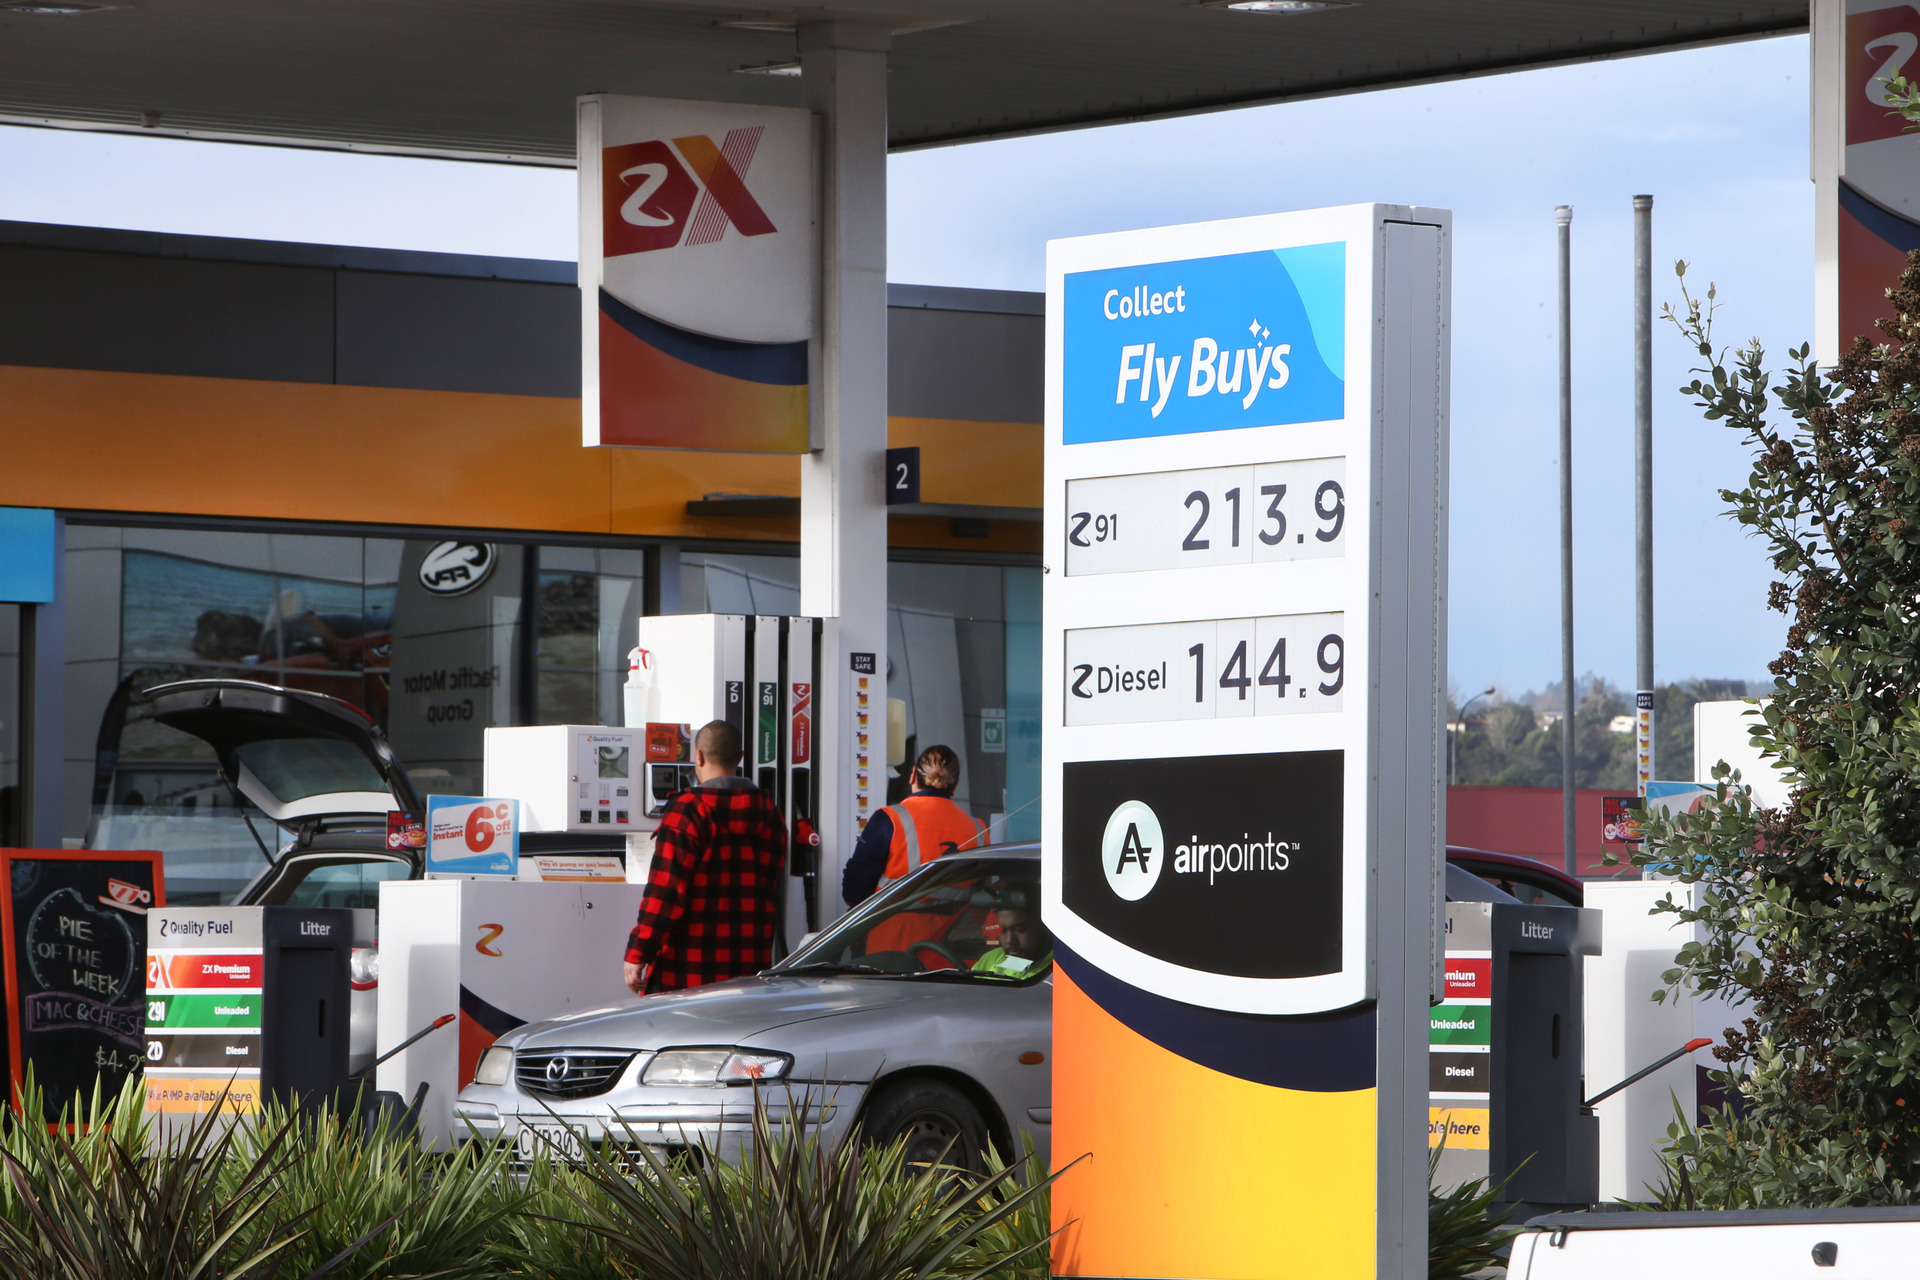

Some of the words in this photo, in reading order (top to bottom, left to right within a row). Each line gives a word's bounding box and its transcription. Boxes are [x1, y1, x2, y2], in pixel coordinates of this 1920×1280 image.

[1103, 284, 1187, 321] Collect
[1115, 342, 1182, 419] Fly
[1187, 336, 1291, 411] Buys
[896, 462, 909, 489] 2
[1182, 480, 1345, 551] 213.9
[1188, 633, 1345, 703] 144.9
[1097, 661, 1167, 694] Diesel
[496, 819, 511, 832] off
[433, 829, 464, 841] Instant
[1174, 831, 1289, 886] airpoints
[58, 915, 94, 942] PIE
[170, 920, 204, 937] Quality
[207, 920, 233, 934] Fuel
[300, 921, 331, 936] Litter
[1521, 921, 1554, 939] Litter
[37, 942, 62, 960] OF
[64, 944, 102, 968] THE
[213, 964, 250, 974] Premium
[73, 968, 120, 995] WEEK
[36, 1001, 73, 1020] MAC
[214, 1006, 250, 1015] Unleaded
[1430, 1019, 1475, 1030] Unleaded
[225, 1046, 249, 1055] Diesel
[1445, 1066, 1475, 1077] Diesel
[184, 1090, 222, 1102] availabl
[1449, 1121, 1481, 1135] here
